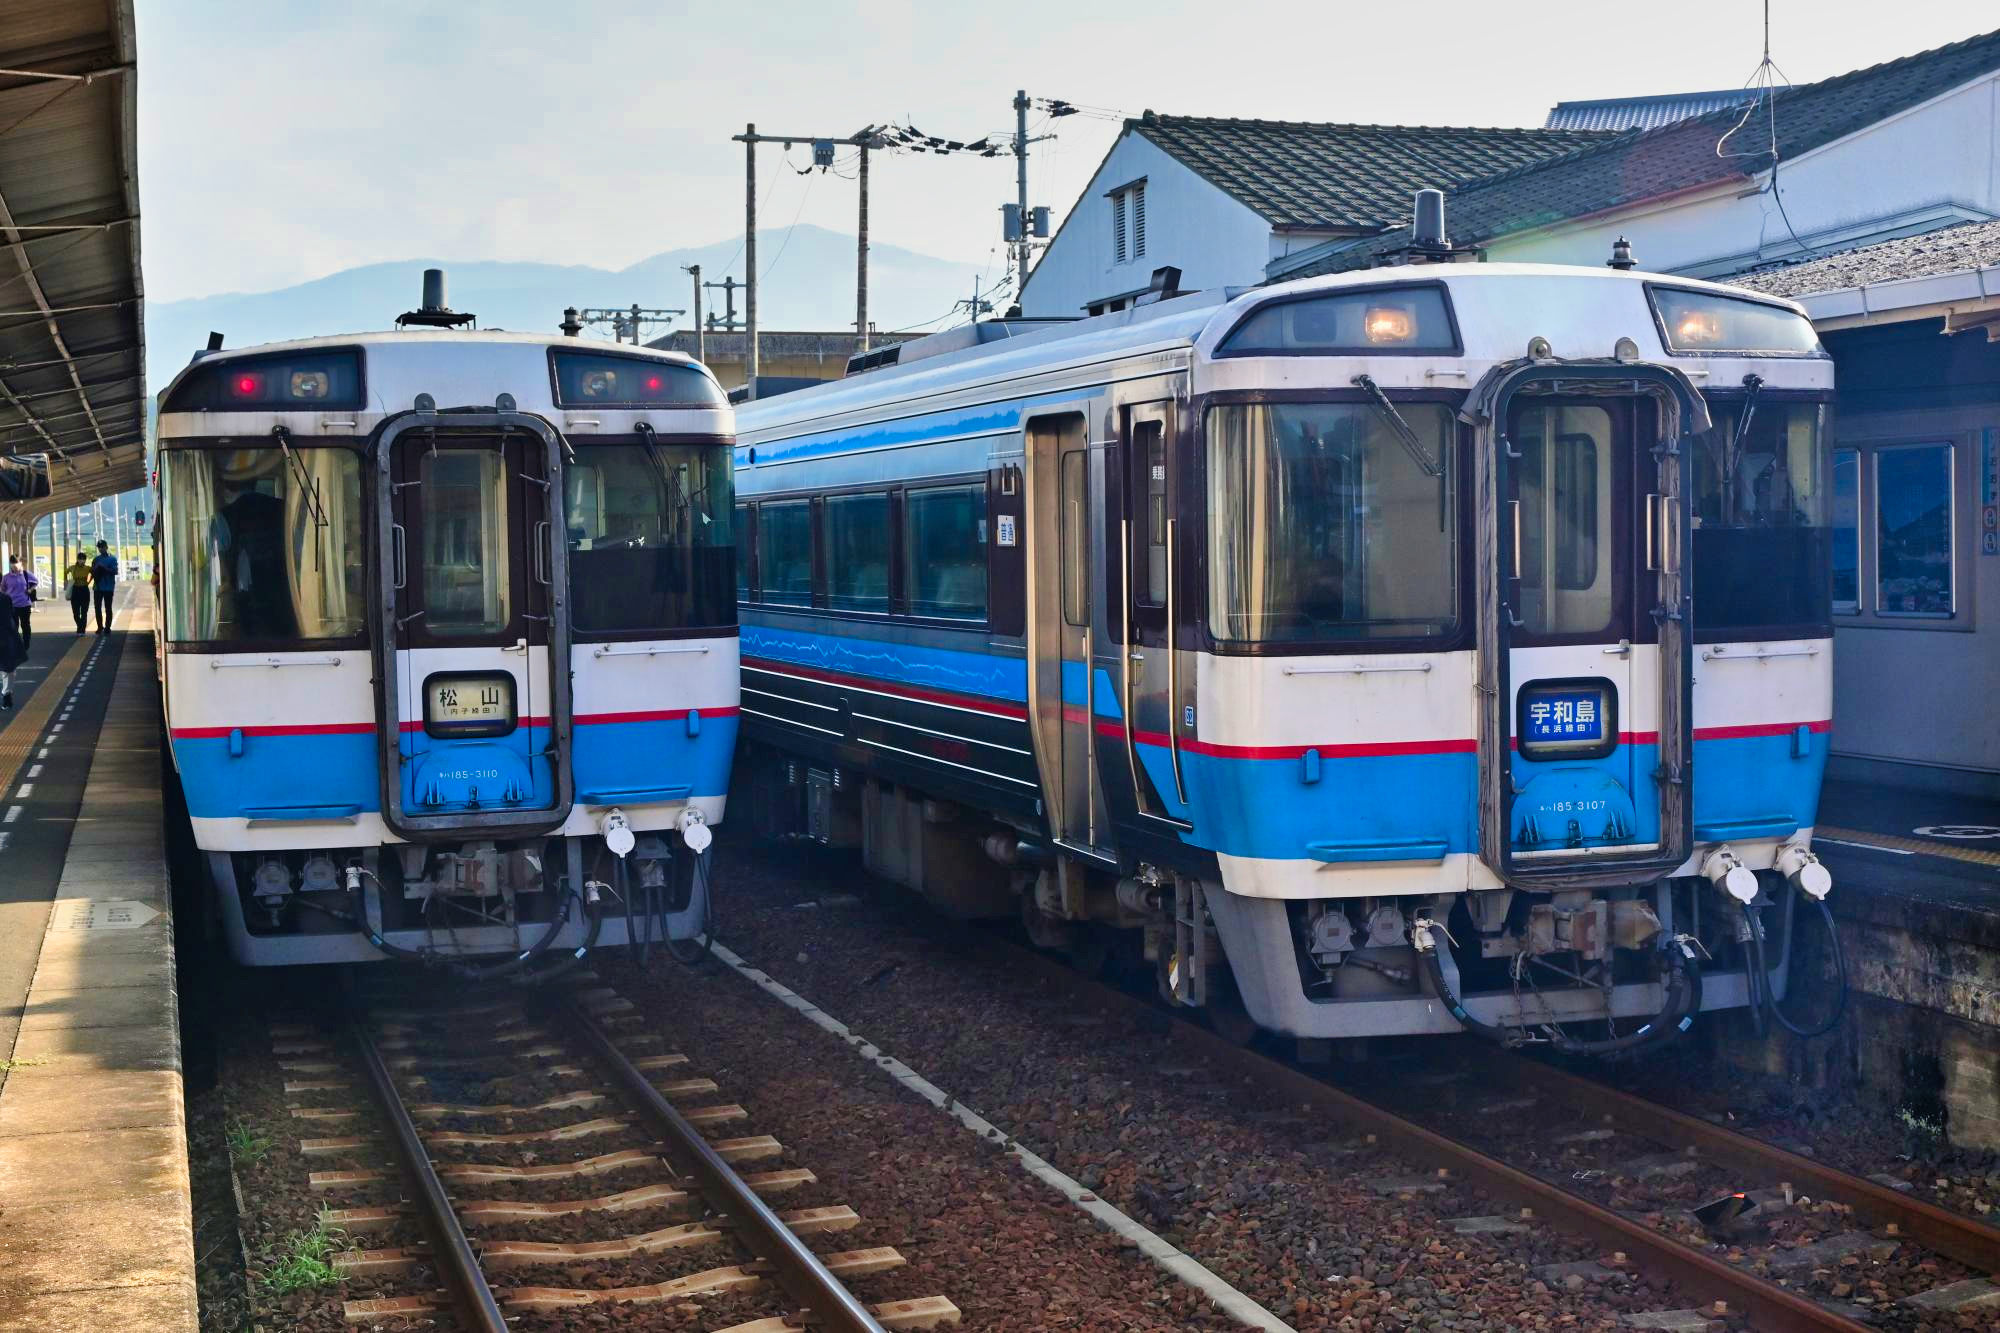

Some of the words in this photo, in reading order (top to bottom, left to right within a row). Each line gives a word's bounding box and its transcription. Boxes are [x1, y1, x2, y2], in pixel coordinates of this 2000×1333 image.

[440, 687, 499, 707] 松山
[1530, 700, 1595, 724] 宇和島
